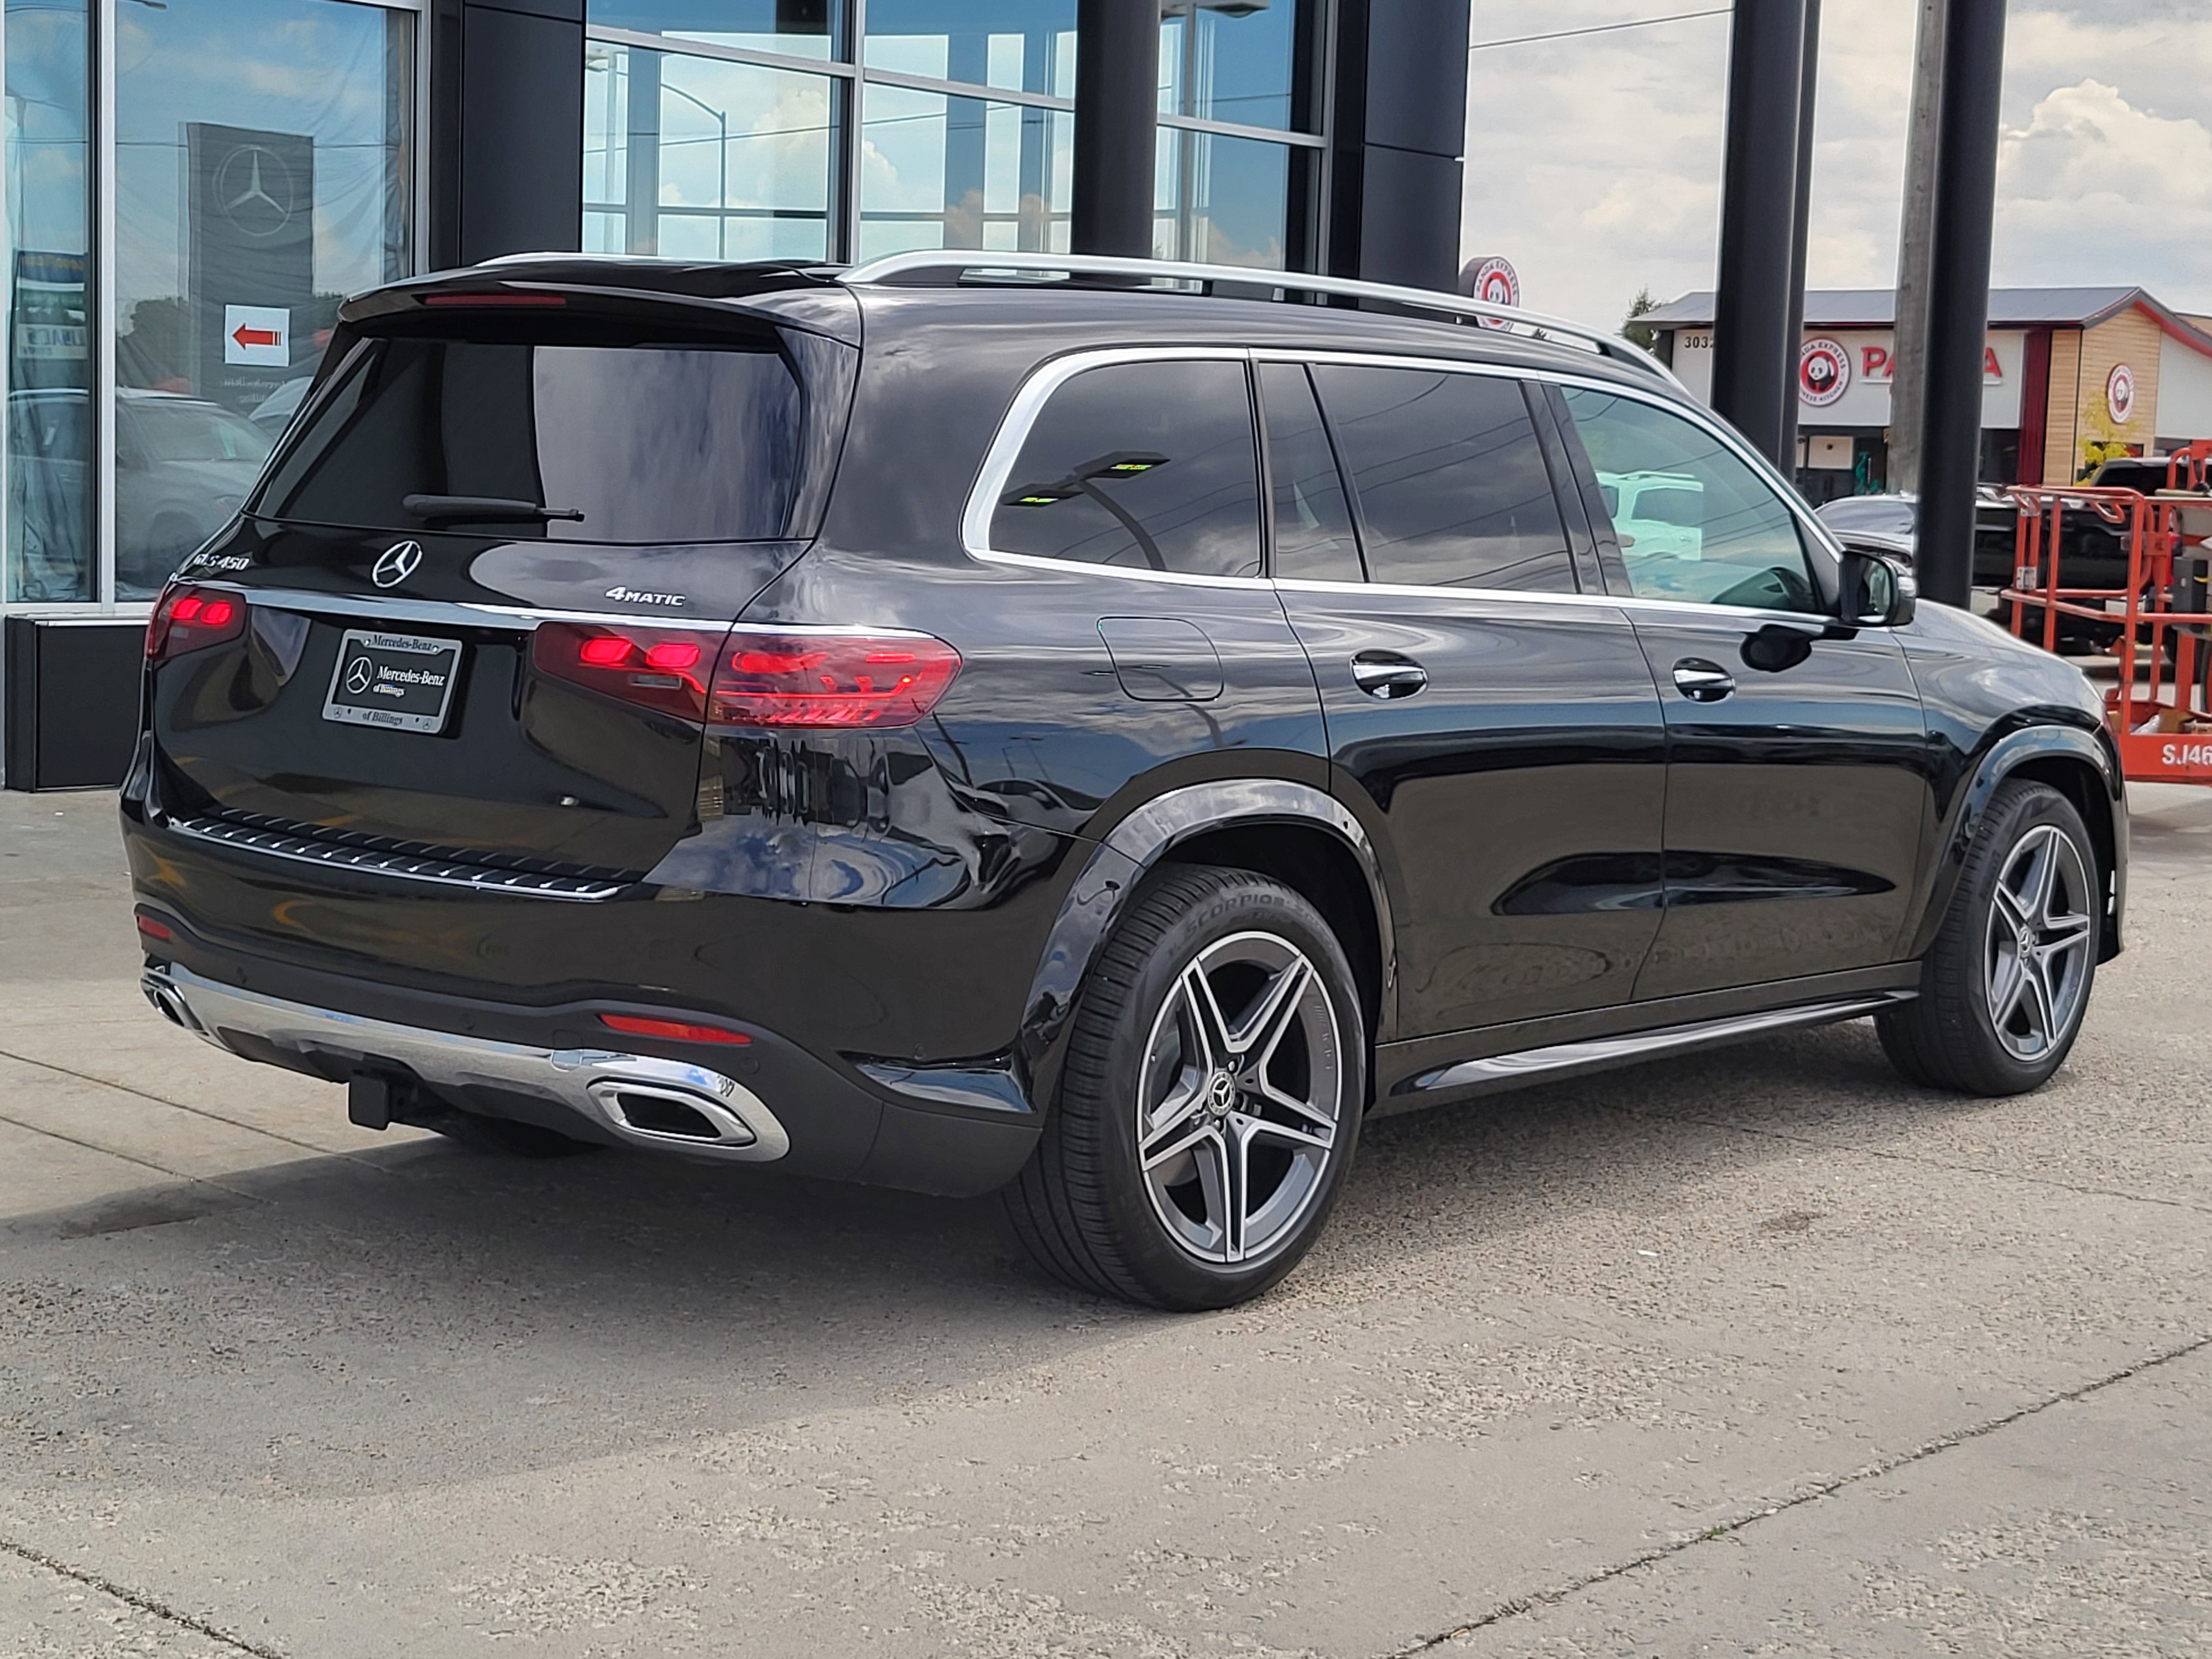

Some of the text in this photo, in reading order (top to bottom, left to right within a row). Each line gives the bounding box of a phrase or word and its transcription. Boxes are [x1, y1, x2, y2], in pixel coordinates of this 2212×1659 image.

[1477, 260, 1517, 295] PANDA EXPRESS
[1818, 342, 1846, 369] EXPRESS
[218, 556, 249, 570] 450
[606, 587, 686, 606] 4MATIC
[372, 635, 431, 651] Mercedes-Benz
[377, 666, 445, 686] Mercedes-Benz
[373, 684, 380, 692] of
[362, 711, 403, 726] of Billings
